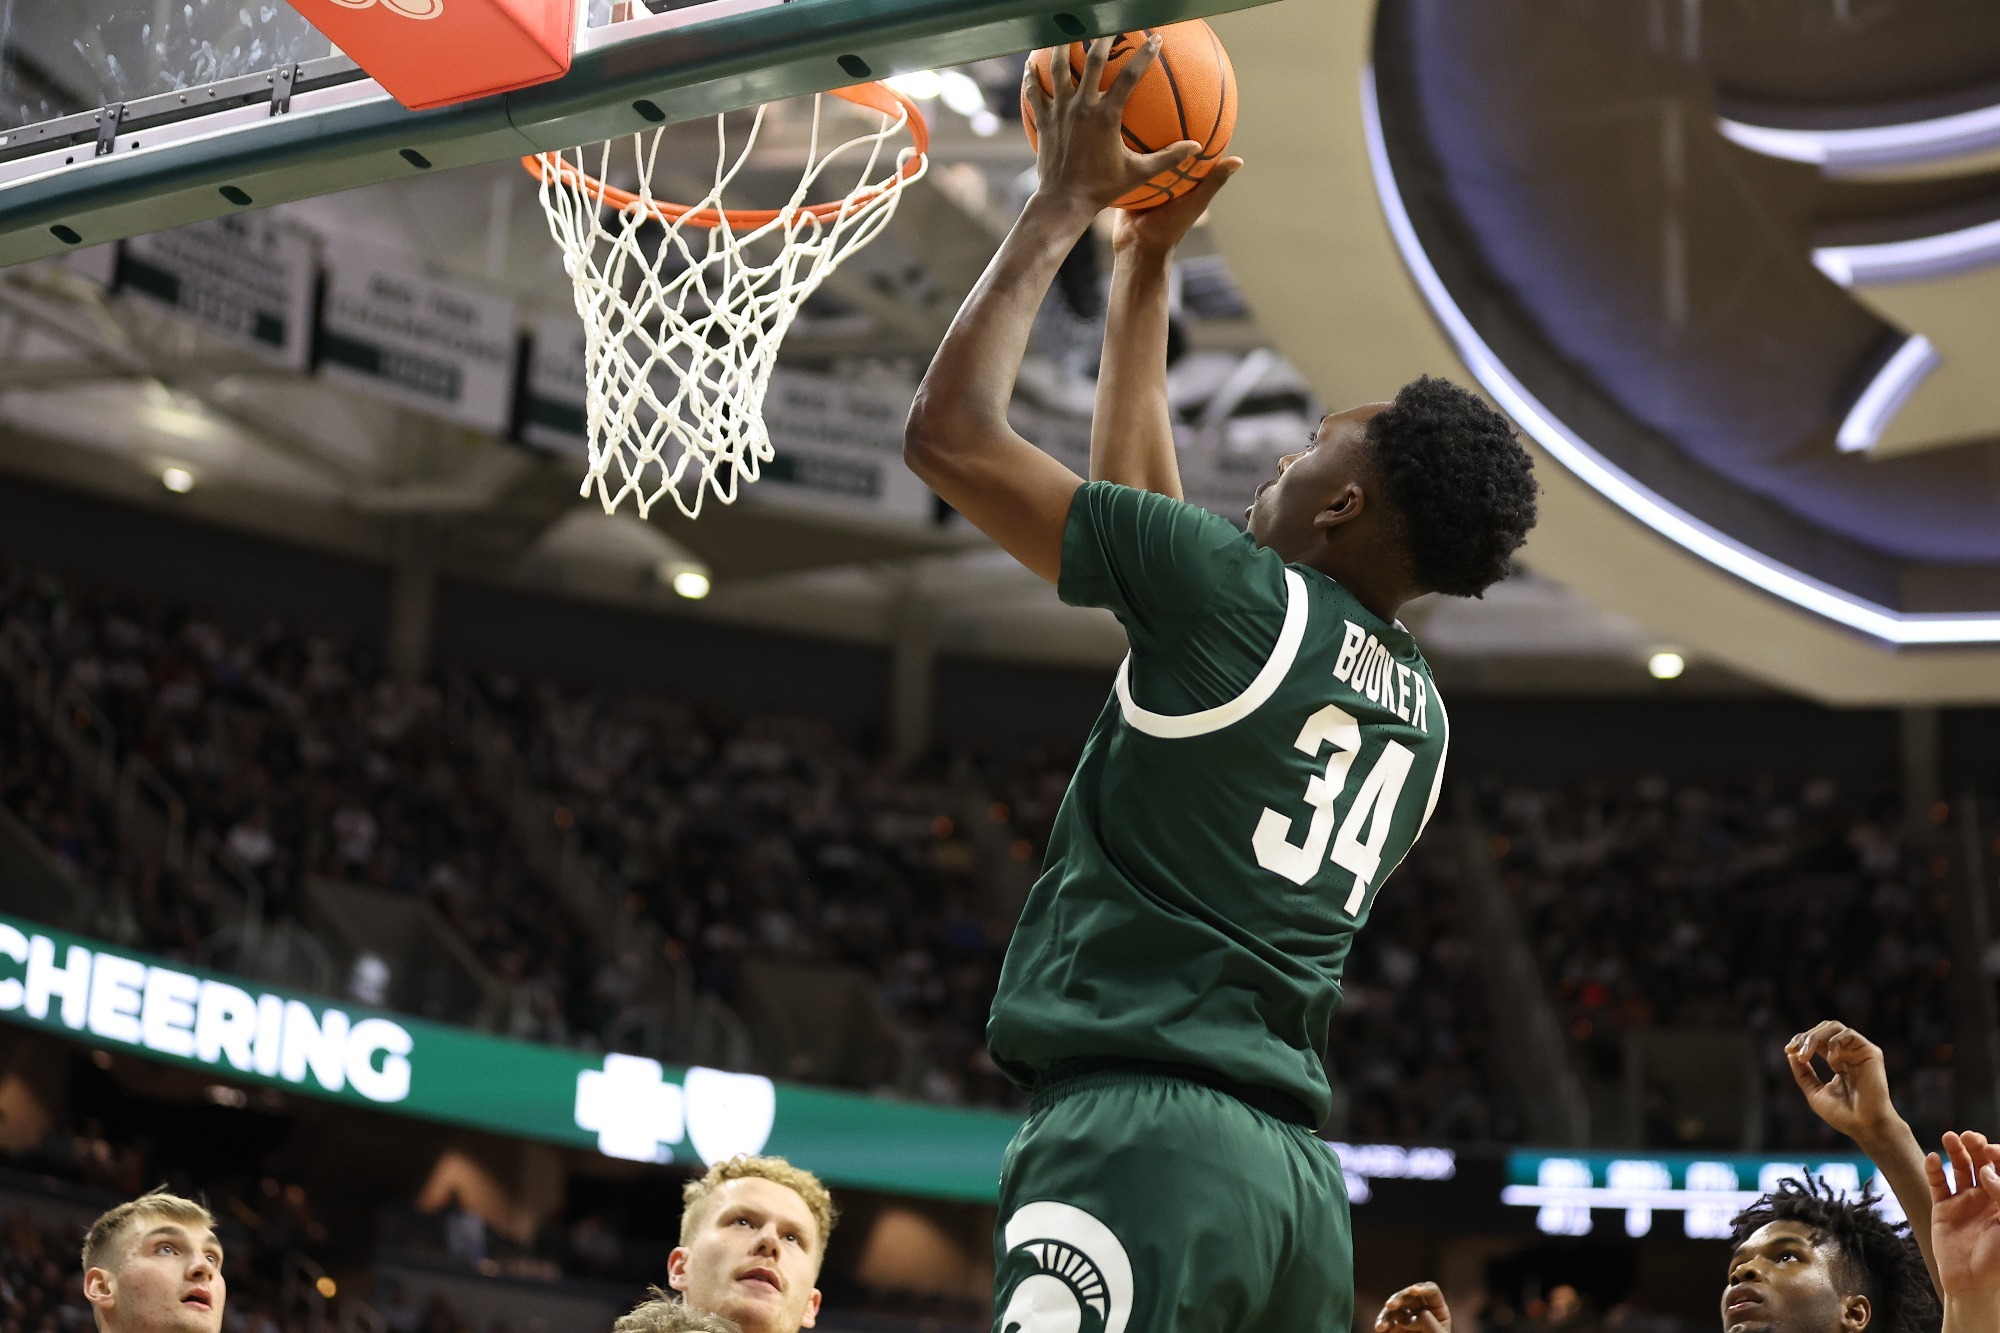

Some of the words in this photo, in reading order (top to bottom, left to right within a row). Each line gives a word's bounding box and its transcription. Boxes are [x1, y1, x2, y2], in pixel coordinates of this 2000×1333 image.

[1332, 619, 1428, 734] BOOKER
[1251, 703, 1416, 918] 34
[0, 922, 413, 1102] CHEERING
